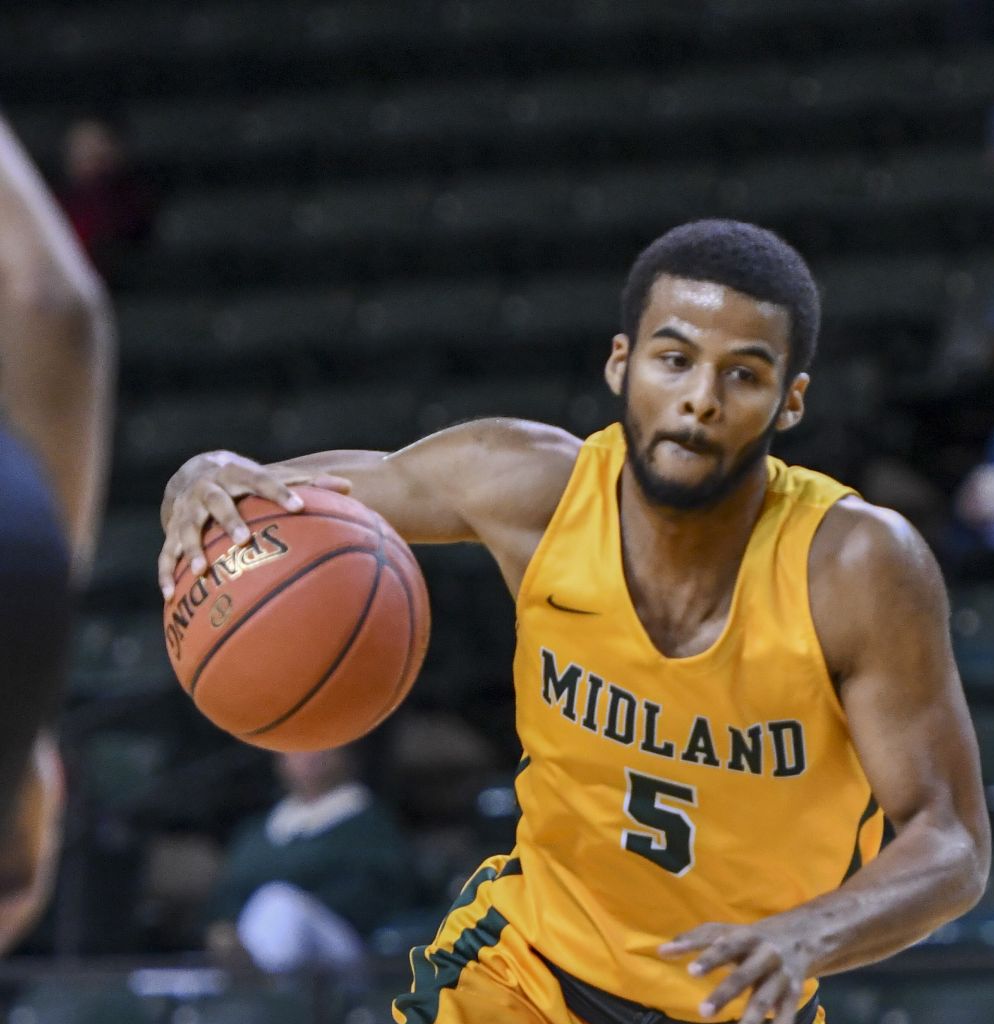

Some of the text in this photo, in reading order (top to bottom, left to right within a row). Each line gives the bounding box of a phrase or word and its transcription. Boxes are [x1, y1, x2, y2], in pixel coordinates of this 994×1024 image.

[165, 523, 289, 661] SPALDING
[540, 646, 808, 779] MIDLAND
[620, 766, 699, 878] 5
